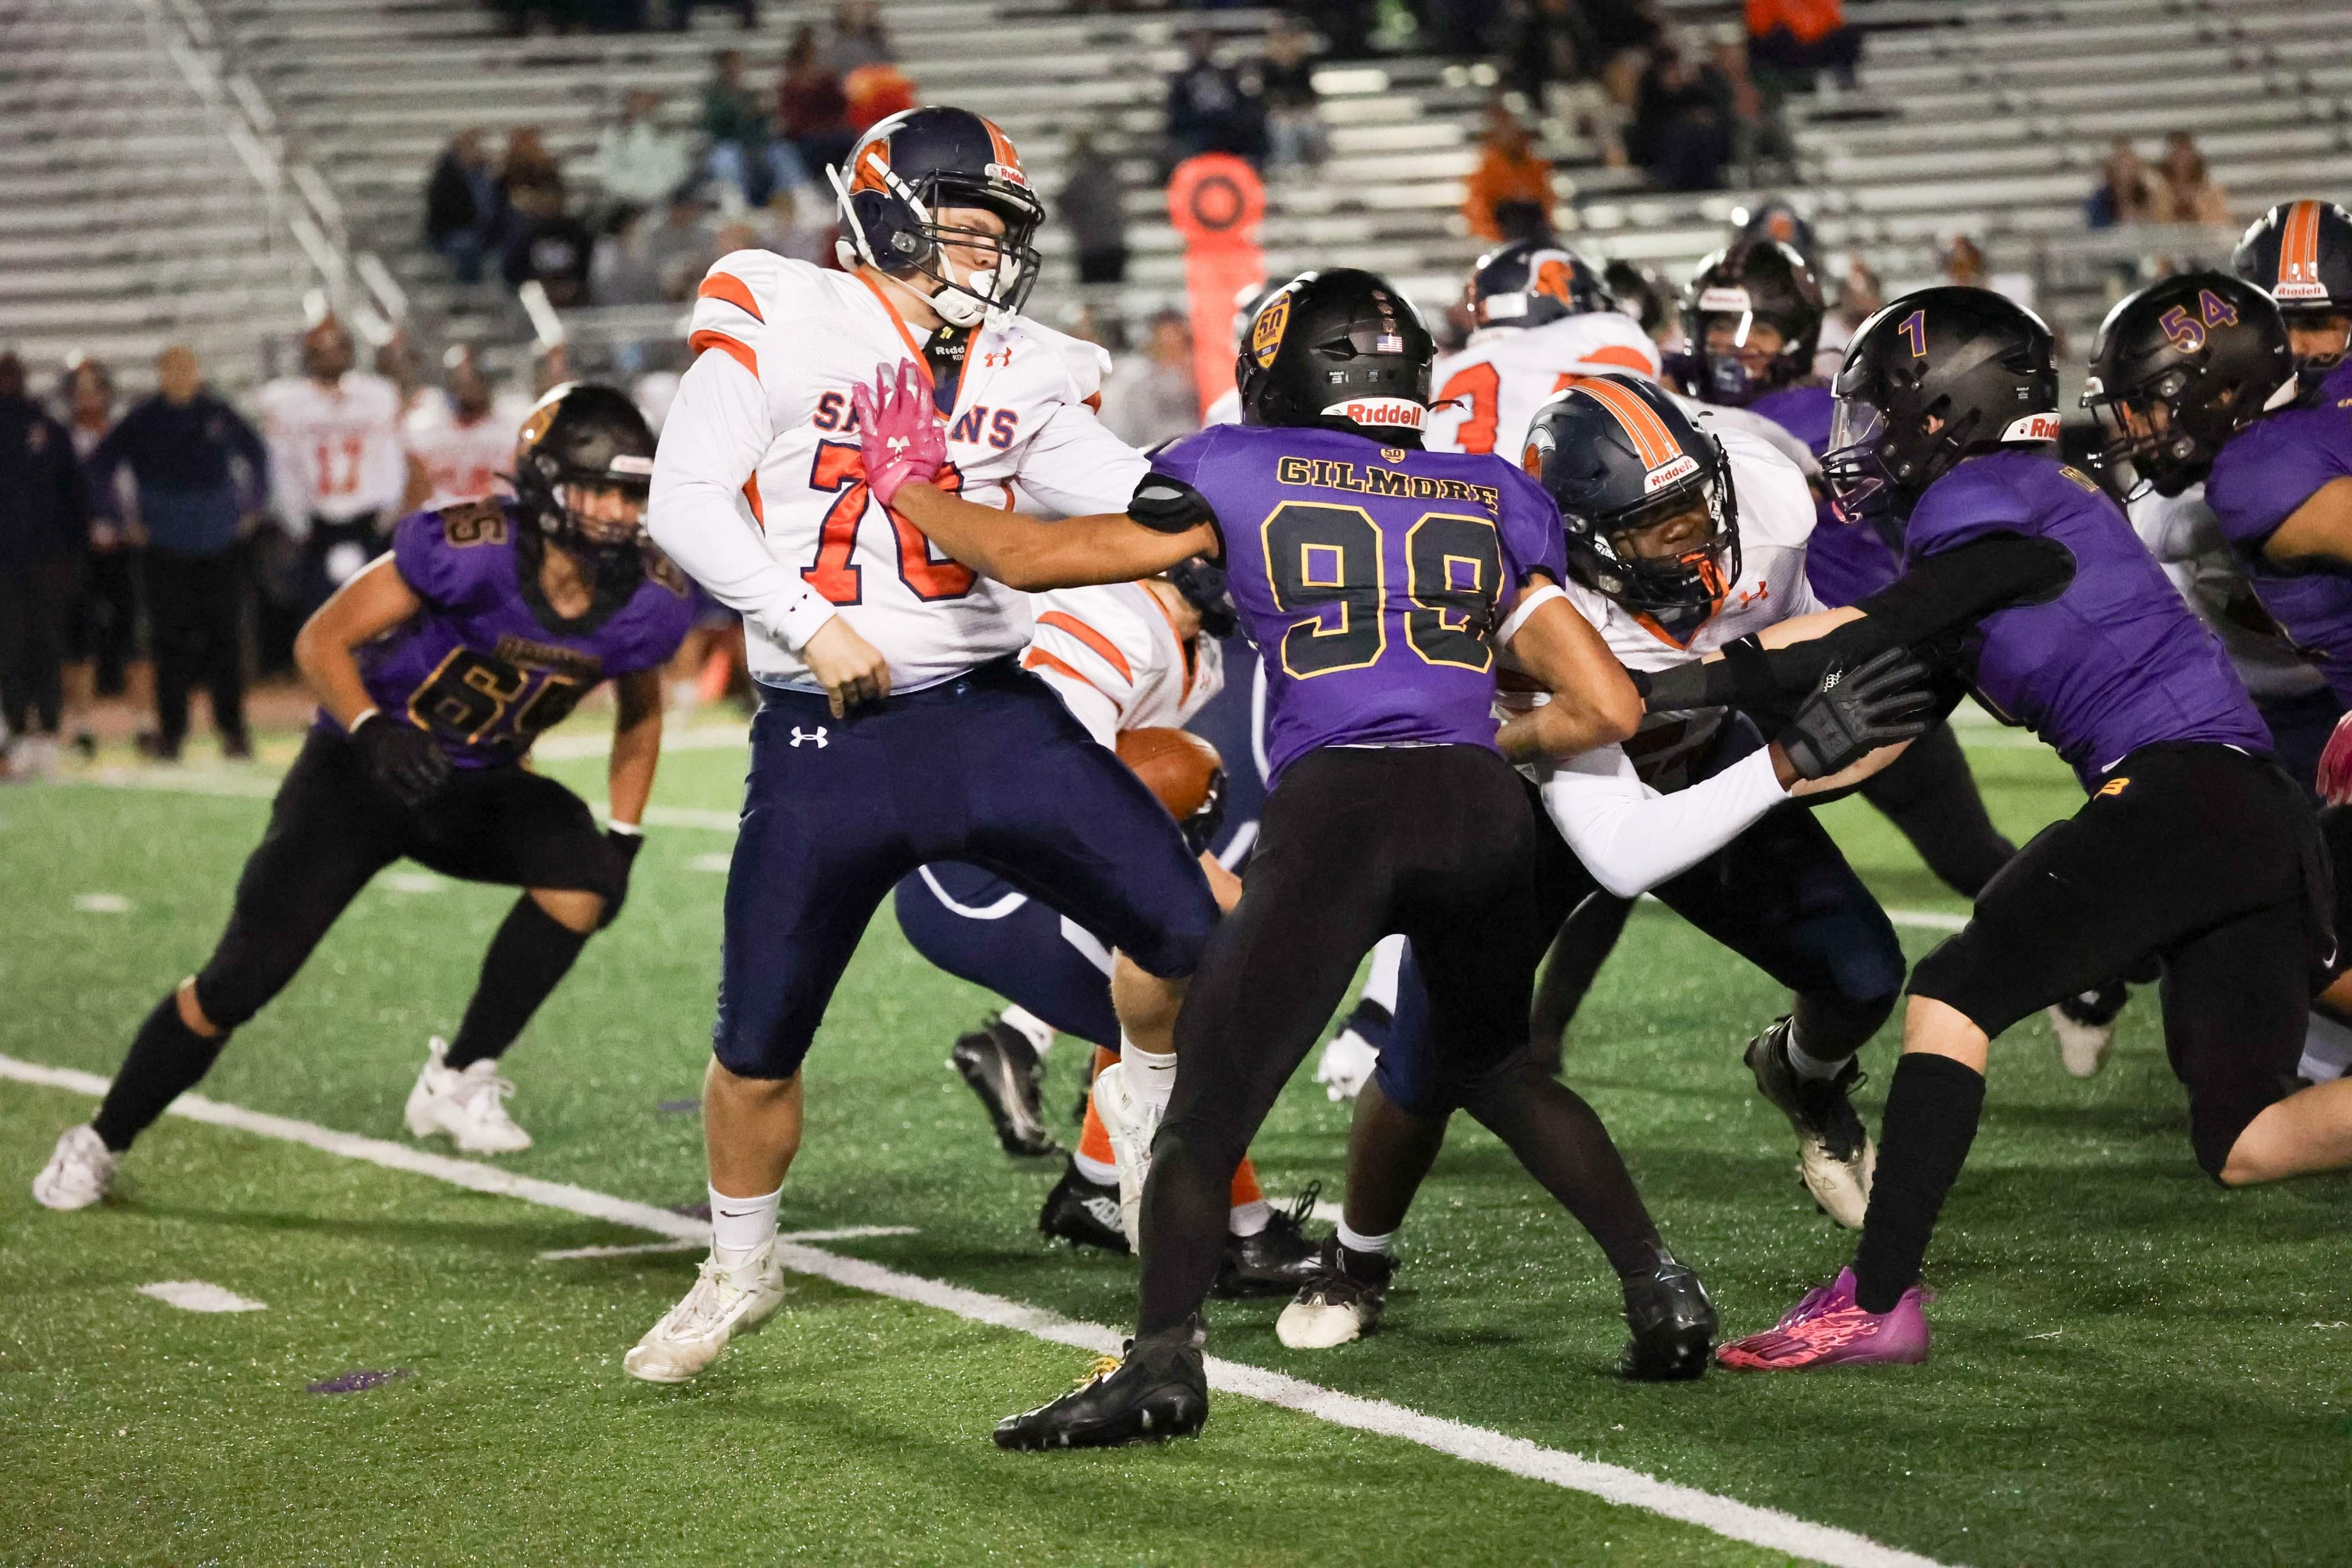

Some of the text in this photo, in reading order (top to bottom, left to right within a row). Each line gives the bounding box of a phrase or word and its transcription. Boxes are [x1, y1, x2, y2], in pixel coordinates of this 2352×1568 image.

[1898, 309, 1927, 358] 1
[2159, 289, 2238, 353] 54
[1347, 404, 1421, 426] Riddell
[1276, 456, 1498, 515] GILMORE
[800, 439, 978, 607] 70
[1260, 501, 1505, 680] 99
